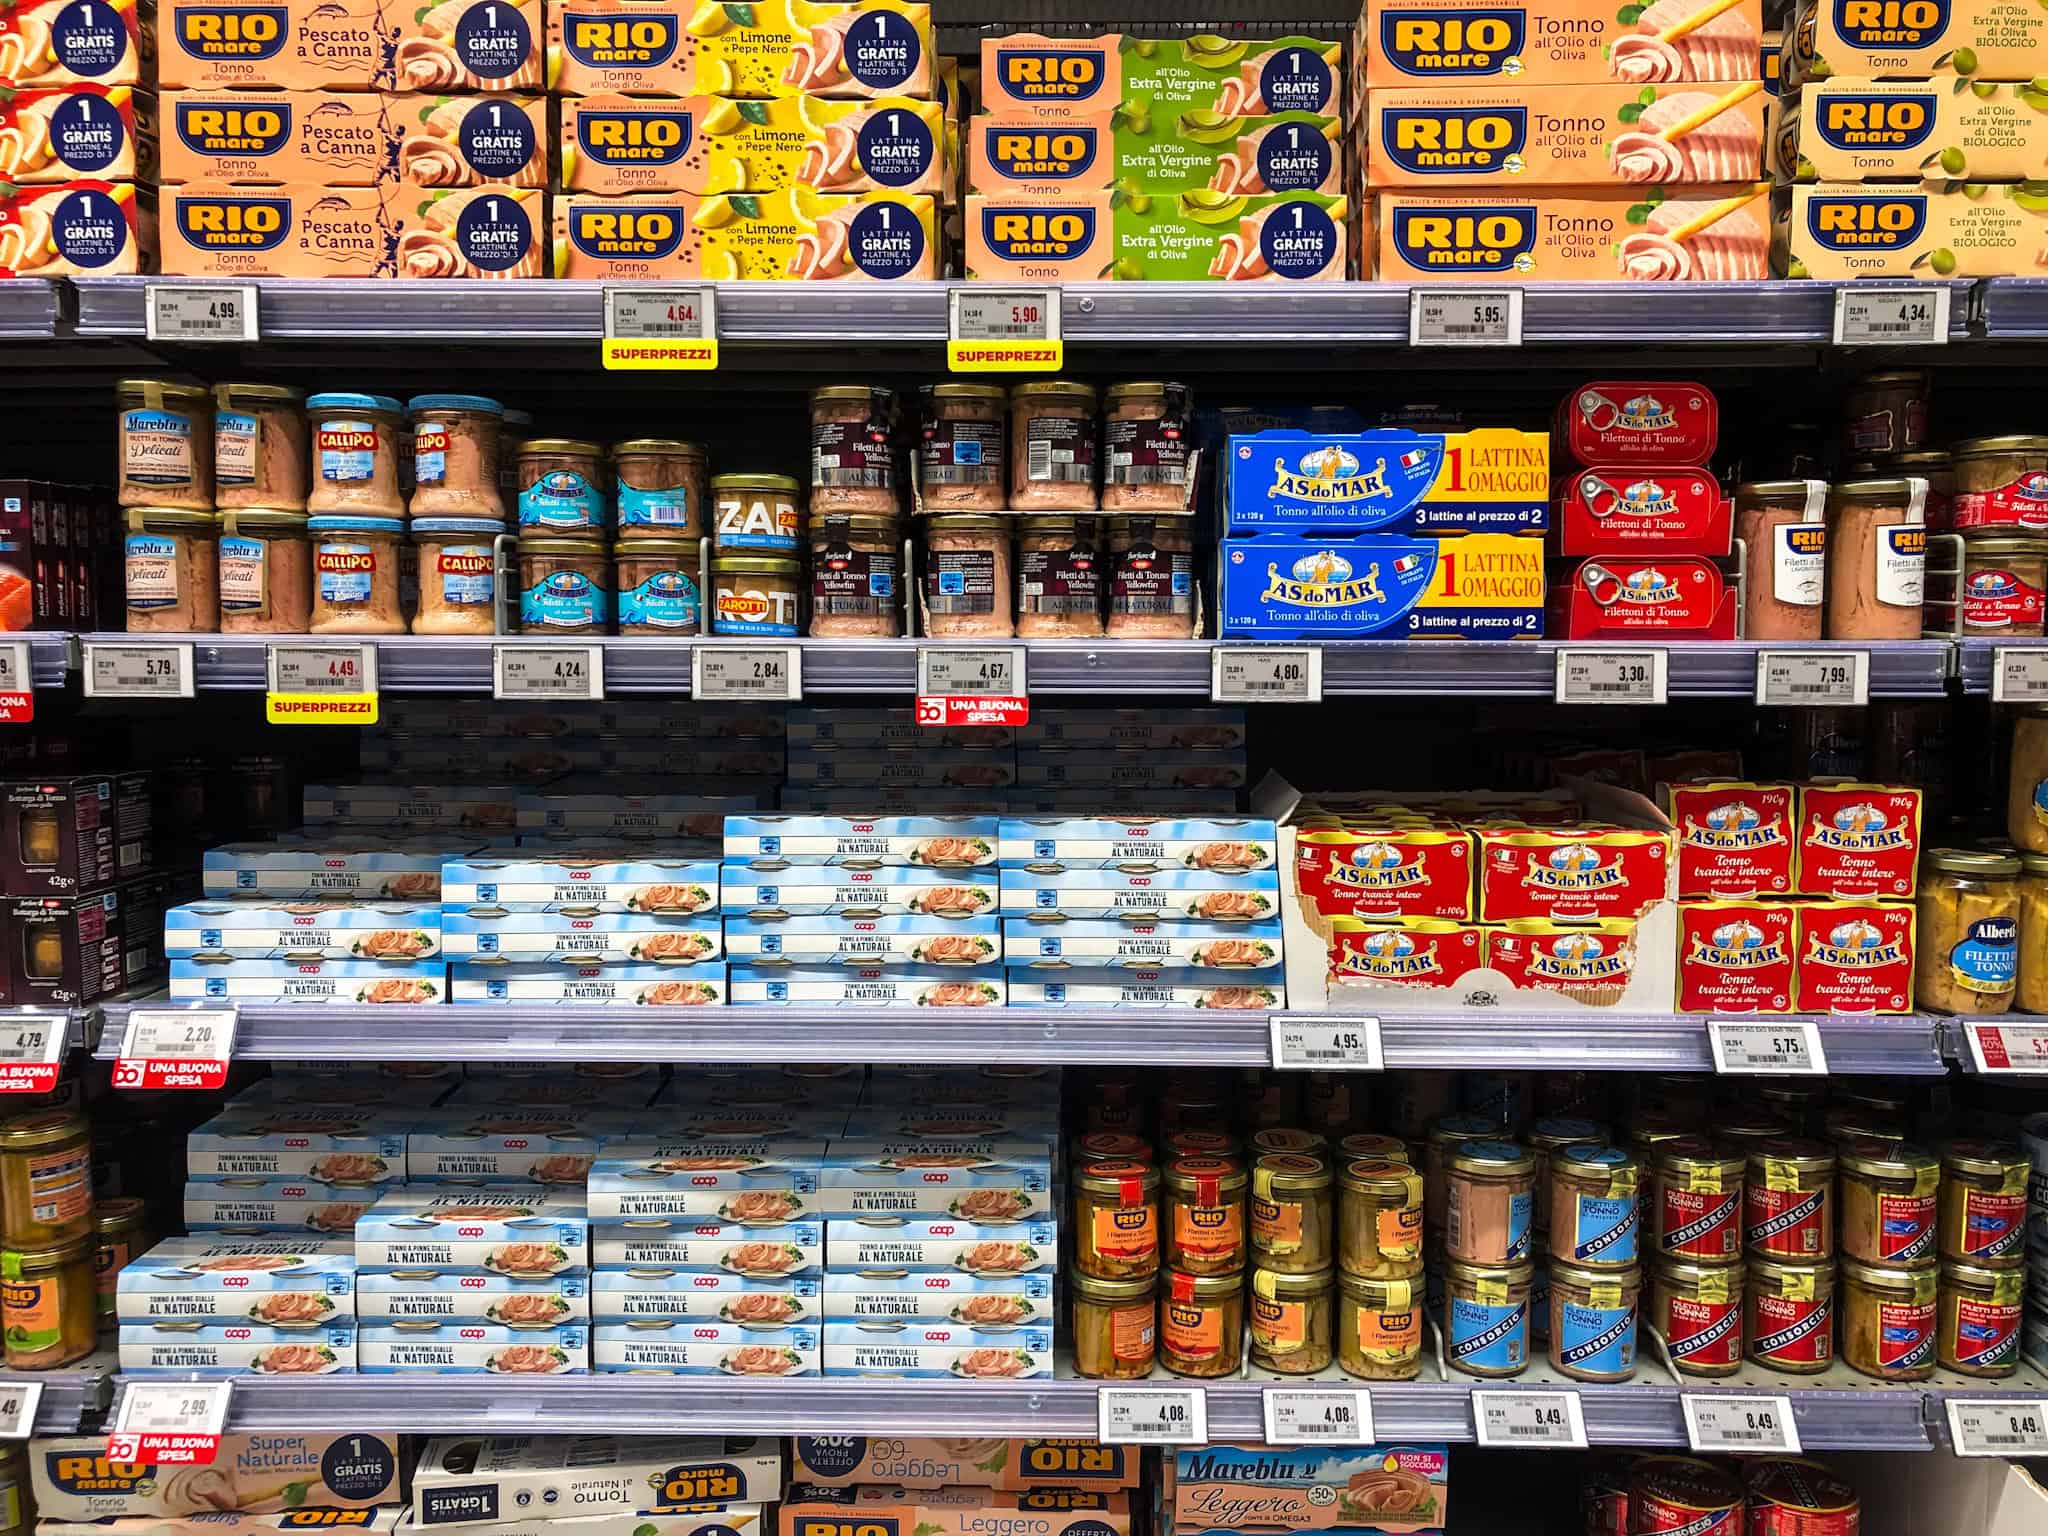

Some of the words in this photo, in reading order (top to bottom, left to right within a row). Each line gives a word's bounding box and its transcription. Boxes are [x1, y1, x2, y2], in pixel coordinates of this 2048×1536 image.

[186, 14, 278, 40] RIO
[875, 17, 885, 38] 1
[299, 28, 369, 42] Pescato
[576, 22, 667, 48] RIO
[740, 32, 792, 44] Limone
[1395, 19, 1511, 52] RIO
[203, 41, 262, 54] mare
[298, 46, 308, 56] a
[313, 41, 372, 57] Canna
[732, 43, 759, 55] Pepe
[763, 43, 788, 53] Nero
[857, 47, 907, 60] GRATIS
[593, 48, 650, 61] mare
[1416, 54, 1490, 67] mare
[214, 63, 254, 74] Tonno
[601, 70, 642, 81] Tonno
[82, 100, 91, 120] 1
[1829, 102, 1925, 129] RIO
[1978, 106, 2015, 116] all'Olio
[1536, 115, 1605, 132] Tonno
[1960, 118, 1988, 127] Extra
[1992, 117, 2031, 130] Vergine
[63, 130, 112, 144] GRATIS
[1846, 130, 1905, 143] mare
[1975, 127, 1983, 137] di
[1988, 127, 2016, 137] Oliva
[473, 136, 522, 149] GRATIS
[1535, 133, 1585, 148] all'Olio
[1590, 134, 1602, 146] di
[1964, 137, 2025, 147] BIOLOGICO
[1552, 147, 1586, 159] Oliva
[994, 214, 1085, 239] RIO
[1149, 224, 1185, 235] all'Olio
[1010, 239, 1067, 254] mare
[1122, 236, 1153, 247] Extra
[1157, 235, 1213, 250] Vergine
[1147, 249, 1157, 259] di
[1160, 249, 1187, 259] Oliva
[1019, 266, 1058, 277] Tonno
[611, 348, 712, 361] SUPERPREZZI
[957, 350, 1056, 362] SUPERPREZZI
[128, 418, 176, 432] Mareblu
[320, 433, 376, 449] CALLIPO
[131, 445, 181, 458] Delicati
[1471, 448, 1545, 466] LATTINA
[1445, 448, 1465, 492] 1
[1468, 473, 1547, 492] OMAGGIO
[1273, 505, 1308, 517] Tonno
[1311, 505, 1347, 517] all'olio
[1348, 505, 1359, 517] di
[1361, 505, 1387, 517] oliva
[1416, 510, 1426, 523] 3
[1429, 511, 1463, 521] lattine
[1465, 511, 1475, 521] al
[1478, 512, 1515, 524] prezzo
[1518, 511, 1528, 521] di
[1532, 510, 1541, 523] 2
[1601, 519, 1640, 530] Filettoni
[1643, 519, 1651, 529] di
[1654, 519, 1685, 530] Tonno
[720, 598, 767, 613] ZAROTTI
[274, 702, 371, 714] SUPERPREZZI
[951, 702, 976, 710] UNA
[979, 702, 1022, 710] BUONA
[968, 712, 1005, 722] SPESA
[1762, 794, 1784, 806] 190g
[1112, 847, 1121, 857] AL
[1125, 846, 1164, 858] NATURALE
[1715, 856, 1752, 866] Tonno
[1695, 866, 1735, 877] trancio
[1738, 866, 1772, 876] intero
[150, 1064, 175, 1072] UNA
[178, 1064, 221, 1073] BUONA
[165, 1076, 202, 1085] SPESA
[1118, 1213, 1145, 1224] RIO
[1671, 1200, 1734, 1243] CONSORCIO
[458, 1227, 483, 1238] coop
[387, 1254, 399, 1263] AL
[402, 1252, 452, 1263] NATURALE
[1457, 1313, 1520, 1355] CONSORCIO
[1676, 1309, 1739, 1354] CONSORCIO
[1761, 1308, 1827, 1350] CONSORCIO
[925, 1331, 950, 1342] coop
[855, 1357, 866, 1367] AL
[870, 1357, 919, 1367] NATURALE
[144, 1437, 171, 1448] UNA
[172, 1437, 214, 1448] BUONA
[250, 1436, 303, 1453] Super
[350, 1439, 362, 1457] 1
[157, 1450, 195, 1461] SPESA
[237, 1451, 319, 1468] Naturale
[816, 1449, 847, 1457] PROVA
[1031, 1448, 1115, 1471] RIO
[811, 1458, 855, 1466] OFFERTA
[1187, 1455, 1296, 1480] Mareblu
[1400, 1461, 1441, 1470] SGOCCIOLA
[335, 1463, 382, 1476] GRATIS
[679, 1468, 725, 1479] mare
[872, 1460, 960, 1483] Leggero
[76, 1478, 131, 1490] mare
[571, 1480, 617, 1490] Naturale
[666, 1476, 738, 1500] RIO
[574, 1491, 631, 1504] Tonno
[1184, 1488, 1304, 1524] Leggero
[1643, 1501, 1677, 1519] TONNO
[960, 1513, 1049, 1536] Leggero
